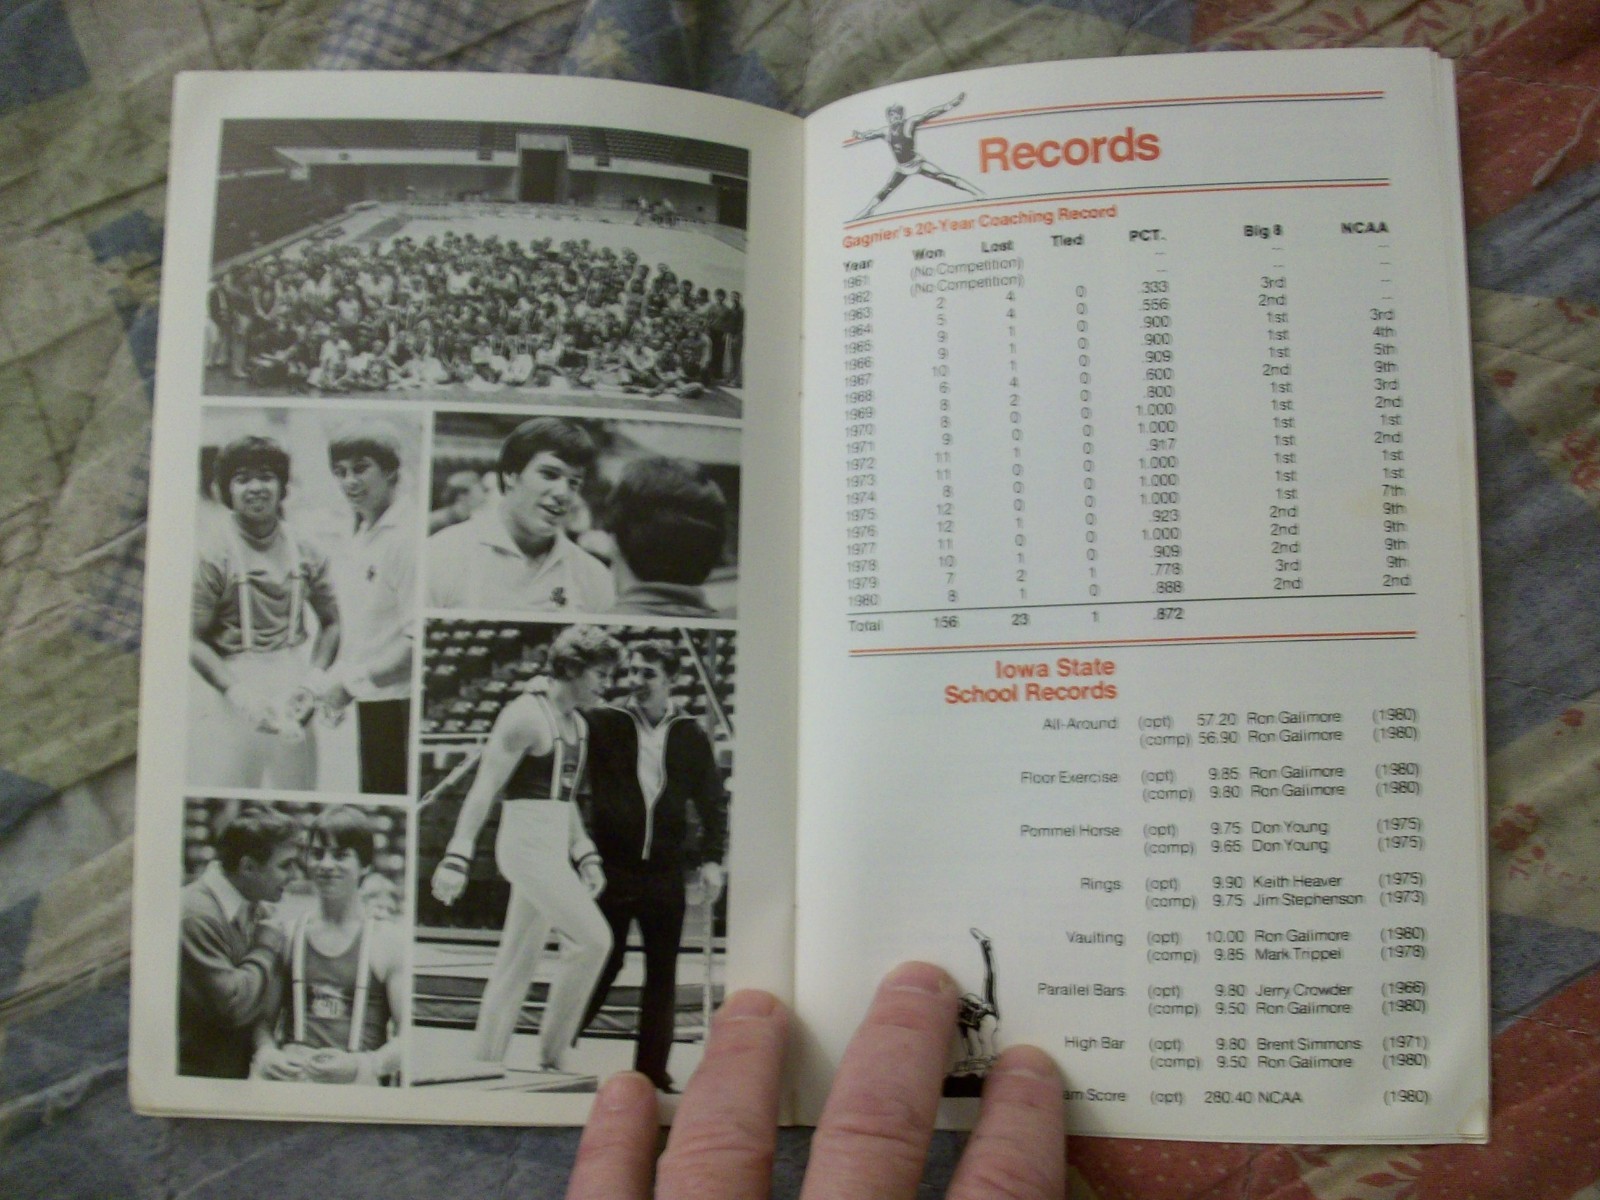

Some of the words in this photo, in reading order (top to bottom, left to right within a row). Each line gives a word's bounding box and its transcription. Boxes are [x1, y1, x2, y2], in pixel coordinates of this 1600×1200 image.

[977, 125, 1162, 174] Records
[842, 226, 913, 249] Gagnier's
[915, 217, 975, 237] 20-Year
[978, 208, 1054, 228] Coaching
[1058, 204, 1118, 221] Record
[843, 259, 874, 272] Year
[912, 248, 946, 261] Won
[981, 239, 1015, 253] Lost
[1050, 233, 1085, 247] Tied
[1128, 228, 1167, 242] PCT.
[1243, 224, 1272, 240] Big
[1272, 223, 1284, 236] 8
[1340, 220, 1390, 234] NCAA
[843, 275, 870, 288] 1961
[938, 257, 1024, 275] Competition)
[844, 290, 872, 304] 1962
[936, 273, 1026, 292] Competition)
[844, 323, 873, 337] 1964
[1258, 293, 1287, 307] 2nd
[845, 356, 874, 370] 1966
[1267, 329, 1289, 341] 1st
[1373, 326, 1397, 338] 4th
[845, 389, 874, 404] 1968
[1262, 363, 1292, 377] 2nd
[1374, 360, 1398, 373] 9th
[845, 423, 875, 437] 1970
[1271, 399, 1294, 411] 1st
[1375, 395, 1404, 409] 2nd
[846, 457, 876, 470] 1972
[1274, 434, 1297, 446] 1st
[1374, 431, 1403, 444] 2nd
[846, 491, 876, 504] 1974
[1275, 470, 1298, 482] 1st
[1383, 467, 1405, 479] 1st
[846, 524, 877, 538] 1976
[1269, 505, 1299, 519] 2nd
[1382, 502, 1407, 515] 9th
[847, 559, 878, 572] 1978
[1271, 540, 1301, 555] 2nd
[1384, 537, 1408, 551] 9th
[848, 594, 879, 607] 1980
[1273, 577, 1303, 591] 2nd
[1382, 574, 1412, 587] 2nd
[848, 620, 883, 632] Total
[933, 615, 960, 629] 156
[1011, 612, 1031, 626] 23
[1091, 610, 1099, 622] 1
[995, 660, 1050, 678] Iowa
[1056, 657, 1117, 677] State
[944, 684, 1019, 705] School
[1024, 682, 1120, 702] Records
[1042, 717, 1119, 730] All-Around
[1138, 715, 1174, 731] (opt)
[1197, 712, 1239, 727] 57.20
[1247, 711, 1276, 724] Ron
[1276, 710, 1344, 724] Galimore
[1139, 733, 1193, 749] (comp)
[1198, 731, 1241, 745] 56.90
[1248, 730, 1277, 743] Ron
[1279, 729, 1345, 743] Galimore
[1020, 771, 1057, 784] Floor
[1057, 770, 1121, 784] Exercise
[1141, 769, 1176, 785] (opt)
[1249, 766, 1279, 780] Ron
[1279, 765, 1346, 779] Galimore
[1142, 787, 1195, 803] (comp)
[1250, 784, 1280, 798] Ron
[1280, 783, 1347, 798] Galimore
[1020, 824, 1078, 837] Pommel
[1078, 824, 1123, 837] Horse
[1143, 823, 1178, 838] (opt)
[1210, 821, 1243, 835] 9.75
[1251, 820, 1282, 834] Don
[1283, 820, 1331, 836] Young
[1143, 842, 1197, 857] (comp)
[1252, 839, 1283, 852] Don
[1284, 839, 1331, 854] Young
[1080, 877, 1123, 893] Rings
[1145, 877, 1180, 892] (opt)
[1212, 875, 1245, 889] 9.90
[1253, 875, 1291, 888] Keith
[1291, 875, 1344, 887] Heaver
[1145, 895, 1198, 910] (comp)
[1212, 894, 1246, 908] 9.75
[1253, 894, 1281, 907] Jim
[1281, 893, 1366, 908] Stephenson
[1066, 931, 1126, 947] Vaulting
[1147, 931, 1183, 946] (opt)
[1206, 929, 1247, 943] 10.00
[1254, 929, 1284, 943] Ron
[1284, 929, 1352, 942] Galimore
[1147, 949, 1200, 964] (comp)
[1255, 948, 1291, 961] Mark
[1293, 947, 1344, 962] Trippel
[1037, 982, 1091, 996] Parallel
[1091, 983, 1127, 997] Bars
[1147, 985, 1183, 999] (opt)
[1255, 984, 1291, 999] Jerry
[1291, 983, 1355, 996] Crowder
[1148, 1003, 1201, 1018] (comp)
[1214, 1001, 1248, 1015] 9.50
[1256, 1001, 1286, 1015] Ron
[1286, 1001, 1354, 1015] Galimore
[1064, 1036, 1100, 1052] High
[1100, 1036, 1126, 1050] Bar
[1148, 1038, 1184, 1053] (opt)
[1256, 1037, 1295, 1051] Brent
[1295, 1037, 1364, 1051] Simmons
[1149, 1056, 1203, 1070] (comp)
[1216, 1055, 1250, 1069] 9.50
[1258, 1055, 1287, 1069] Ron
[1287, 1055, 1355, 1069] Galimore
[1086, 1088, 1127, 1102] Score
[1149, 1091, 1186, 1106] (opt)
[1258, 1090, 1304, 1105] NCAA
